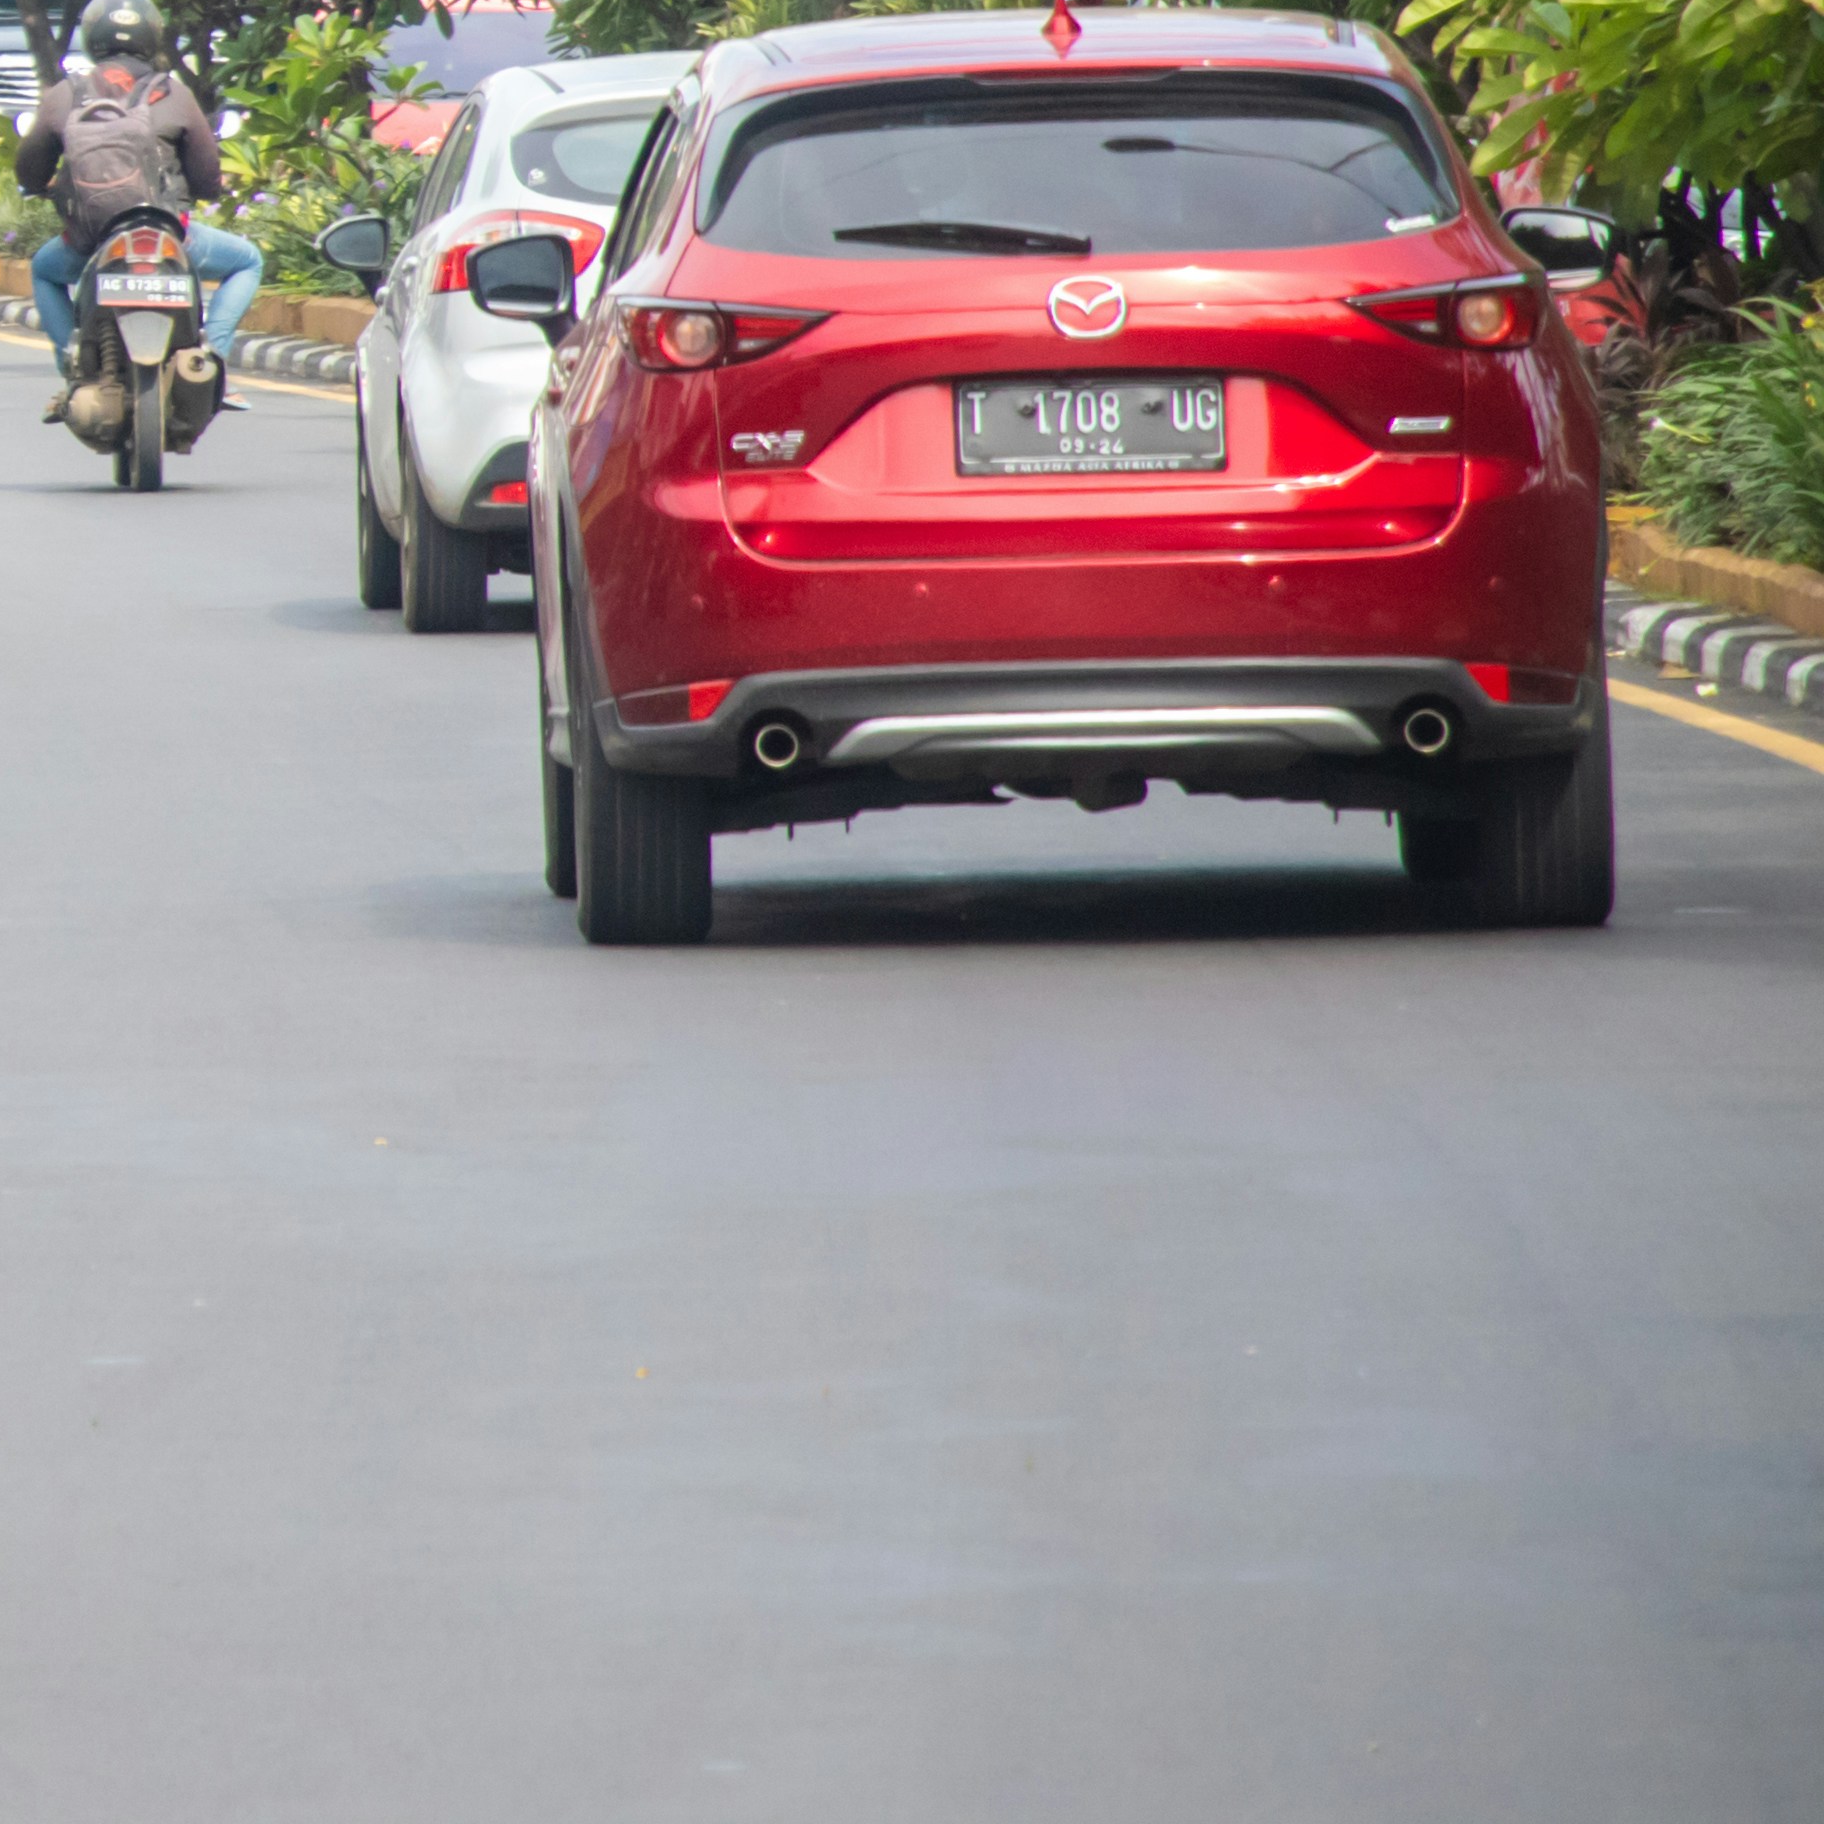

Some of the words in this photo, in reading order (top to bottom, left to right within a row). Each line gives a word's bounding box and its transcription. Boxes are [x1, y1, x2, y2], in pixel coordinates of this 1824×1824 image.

[967, 391, 988, 434] T
[1033, 390, 1122, 435] 1708
[1172, 389, 1218, 433] UG
